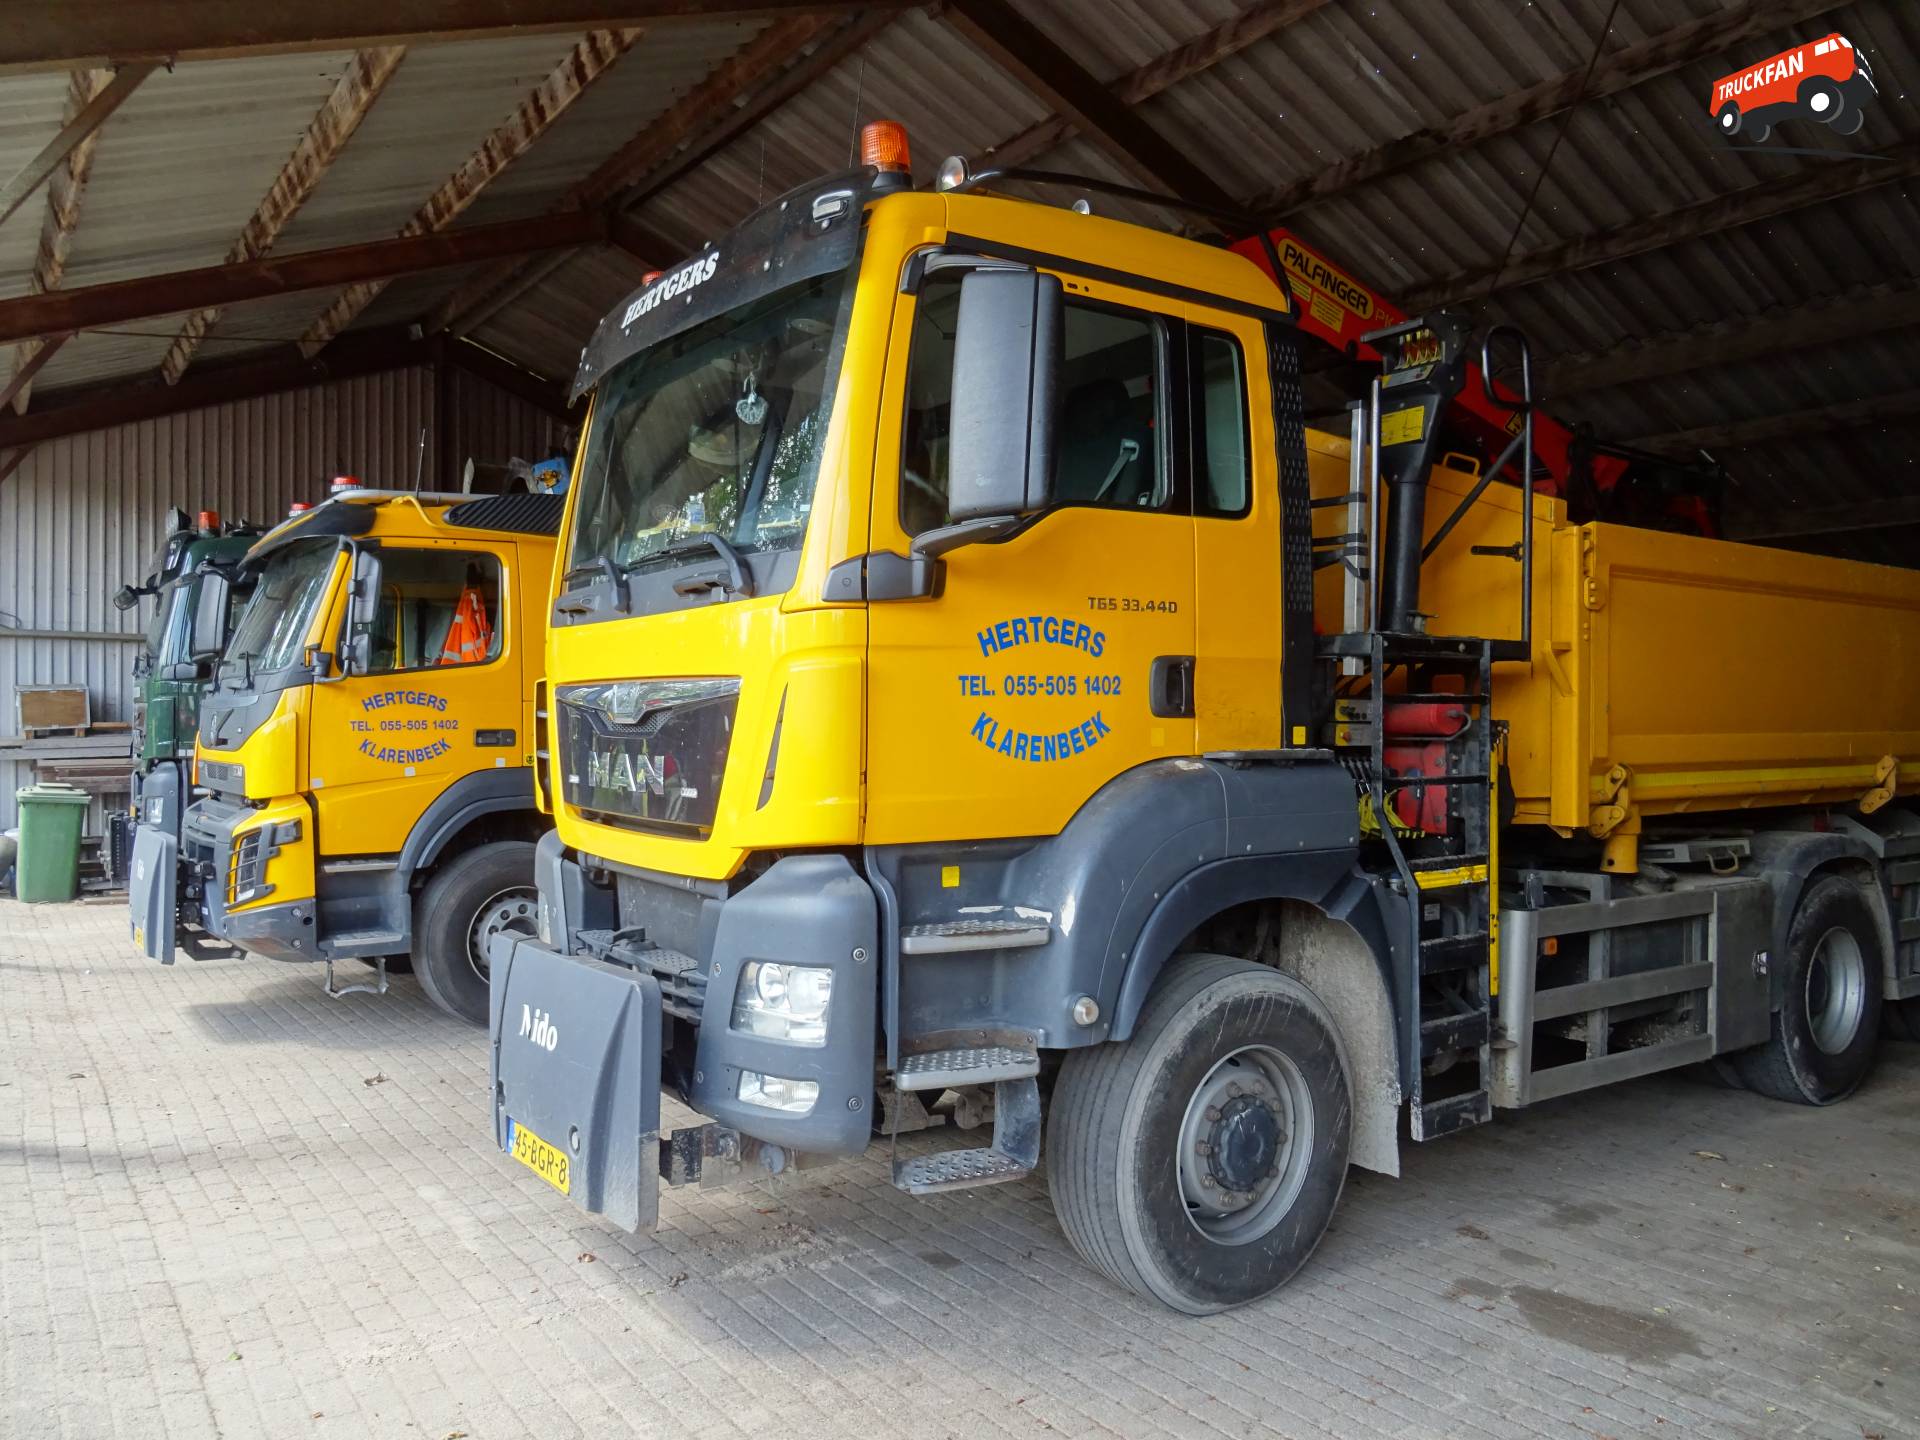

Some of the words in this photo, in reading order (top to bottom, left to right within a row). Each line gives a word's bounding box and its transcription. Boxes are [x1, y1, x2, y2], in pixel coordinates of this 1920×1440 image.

[620, 251, 719, 329] HERTGERS
[1284, 243, 1369, 314] PALFINGER
[1088, 597, 1117, 611] TGS
[1122, 598, 1178, 613] 33.440
[977, 616, 1106, 657] HERTGERS
[362, 690, 448, 712] HERTGERS
[958, 675, 996, 696] TEL.
[1004, 675, 1077, 696] 055-505
[1084, 675, 1121, 695] 1402
[350, 720, 375, 731] TEL.
[380, 720, 428, 731] 055-505
[433, 719, 459, 730] 1402
[971, 710, 1111, 762] KLARENBEEK
[359, 738, 452, 764] KLARENBEEK
[588, 751, 665, 795] MAN
[519, 1004, 558, 1051] Nido
[515, 1129, 567, 1185] 45-BGR-8
